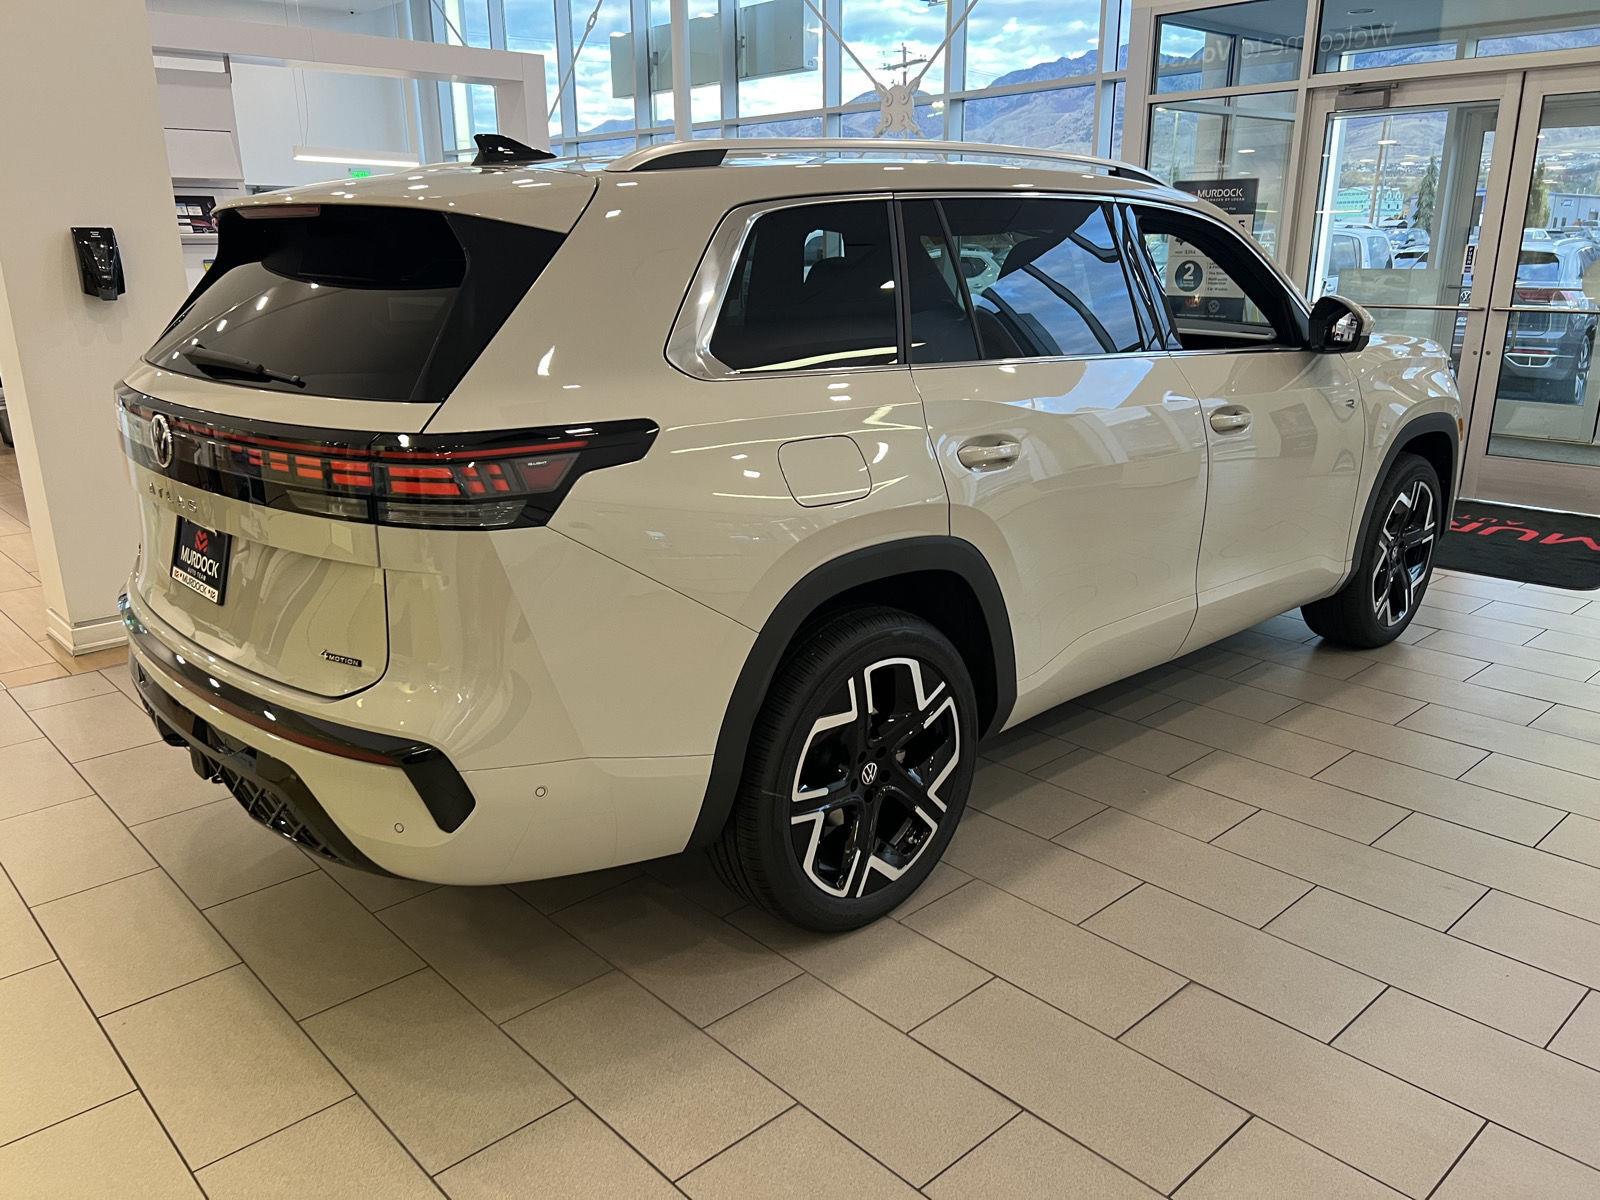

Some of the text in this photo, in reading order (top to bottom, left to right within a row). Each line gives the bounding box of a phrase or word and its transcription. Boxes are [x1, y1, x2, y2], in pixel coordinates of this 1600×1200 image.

[1197, 188, 1242, 197] MURDOCK
[1183, 263, 1194, 280] 2
[181, 545, 219, 578] MURDOCK
[182, 574, 207, 595] MURDOCK
